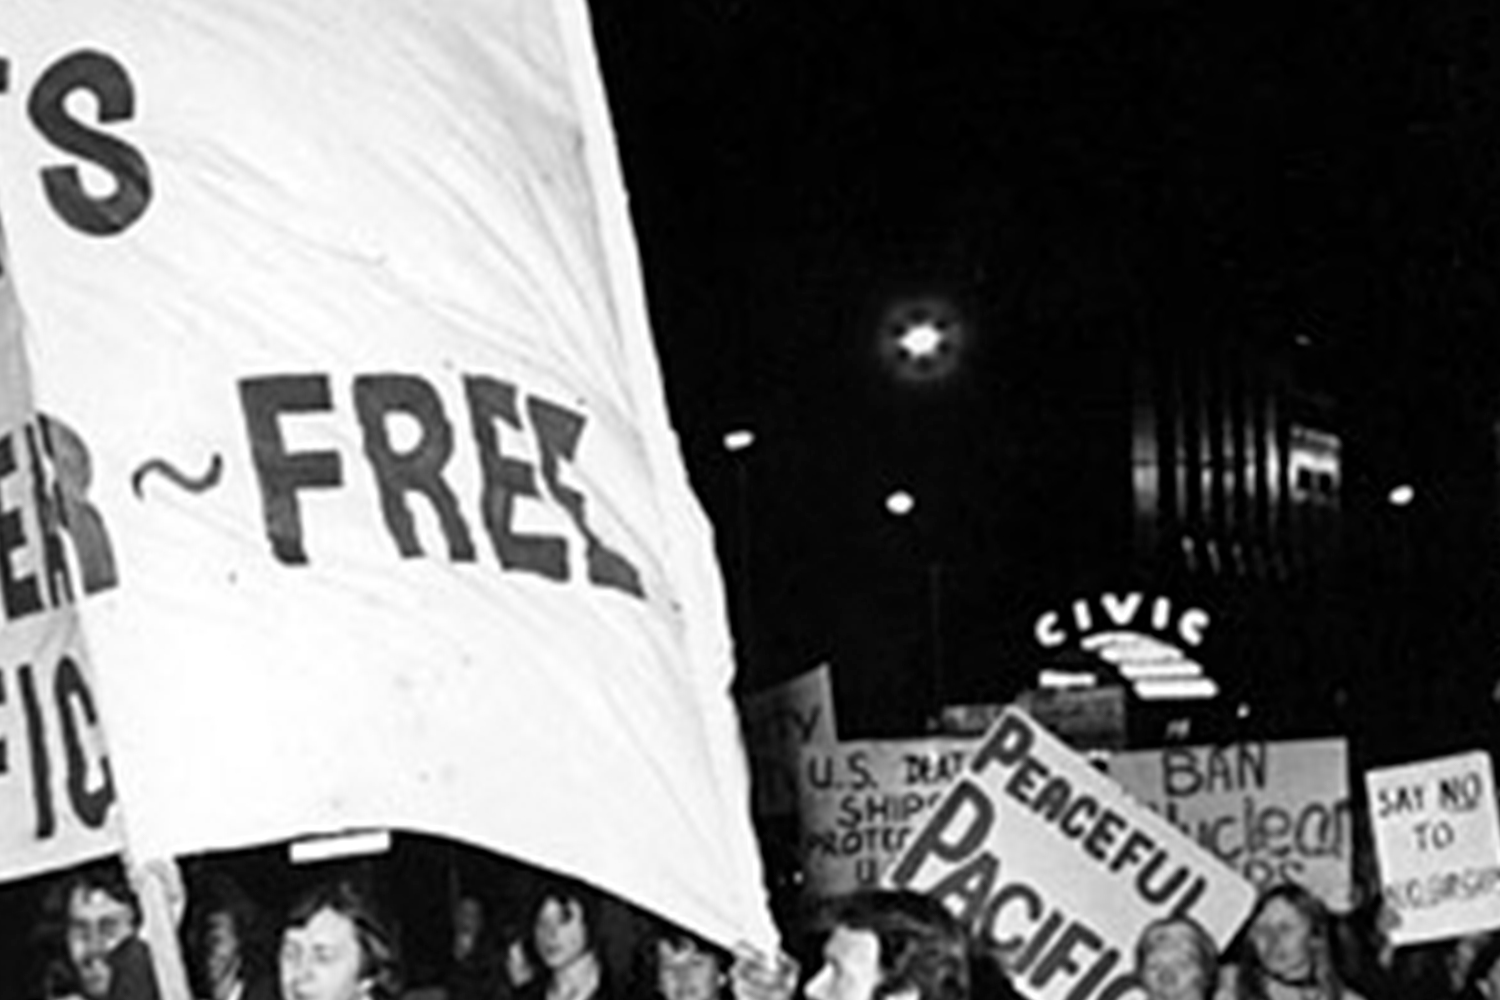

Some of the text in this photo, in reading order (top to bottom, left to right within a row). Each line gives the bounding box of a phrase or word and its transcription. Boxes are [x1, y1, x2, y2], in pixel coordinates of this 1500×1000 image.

[1035, 591, 1211, 648] CIVIC
[1162, 740, 1268, 797] BAN
[1378, 772, 1484, 819] SAY NO
[970, 713, 1208, 918] PEACEFUL
[1147, 798, 1351, 862] clear
[1414, 820, 1456, 851] TO
